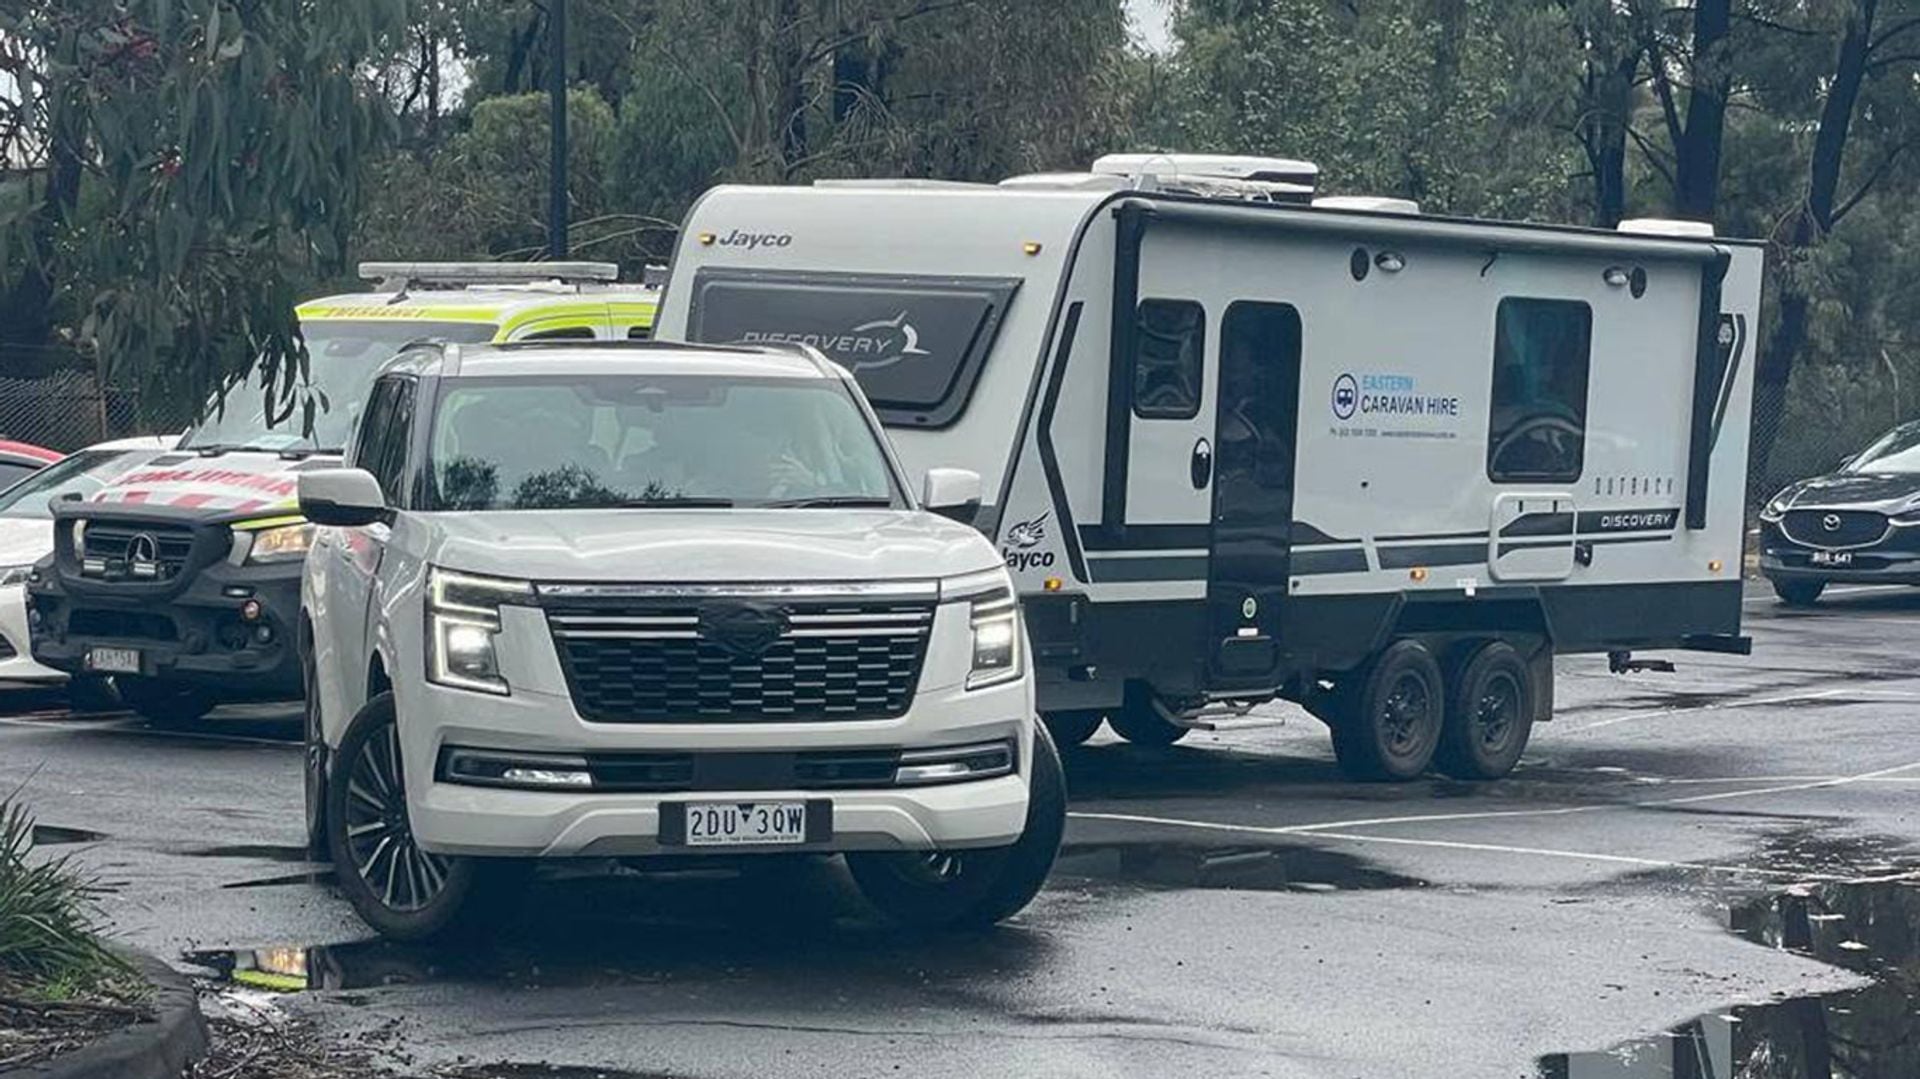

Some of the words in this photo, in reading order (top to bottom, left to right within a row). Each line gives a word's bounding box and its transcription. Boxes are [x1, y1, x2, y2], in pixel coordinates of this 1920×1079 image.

[719, 229, 793, 250] Jayco
[1362, 375, 1415, 391] EASTERN
[1361, 394, 1424, 415] CARAVAN
[1426, 397, 1458, 416] HIRE
[1595, 477, 1673, 496] OUTBACK
[1601, 513, 1671, 528] DISCOVERY
[691, 809, 736, 836] 2DU
[757, 808, 802, 834] 3QW
